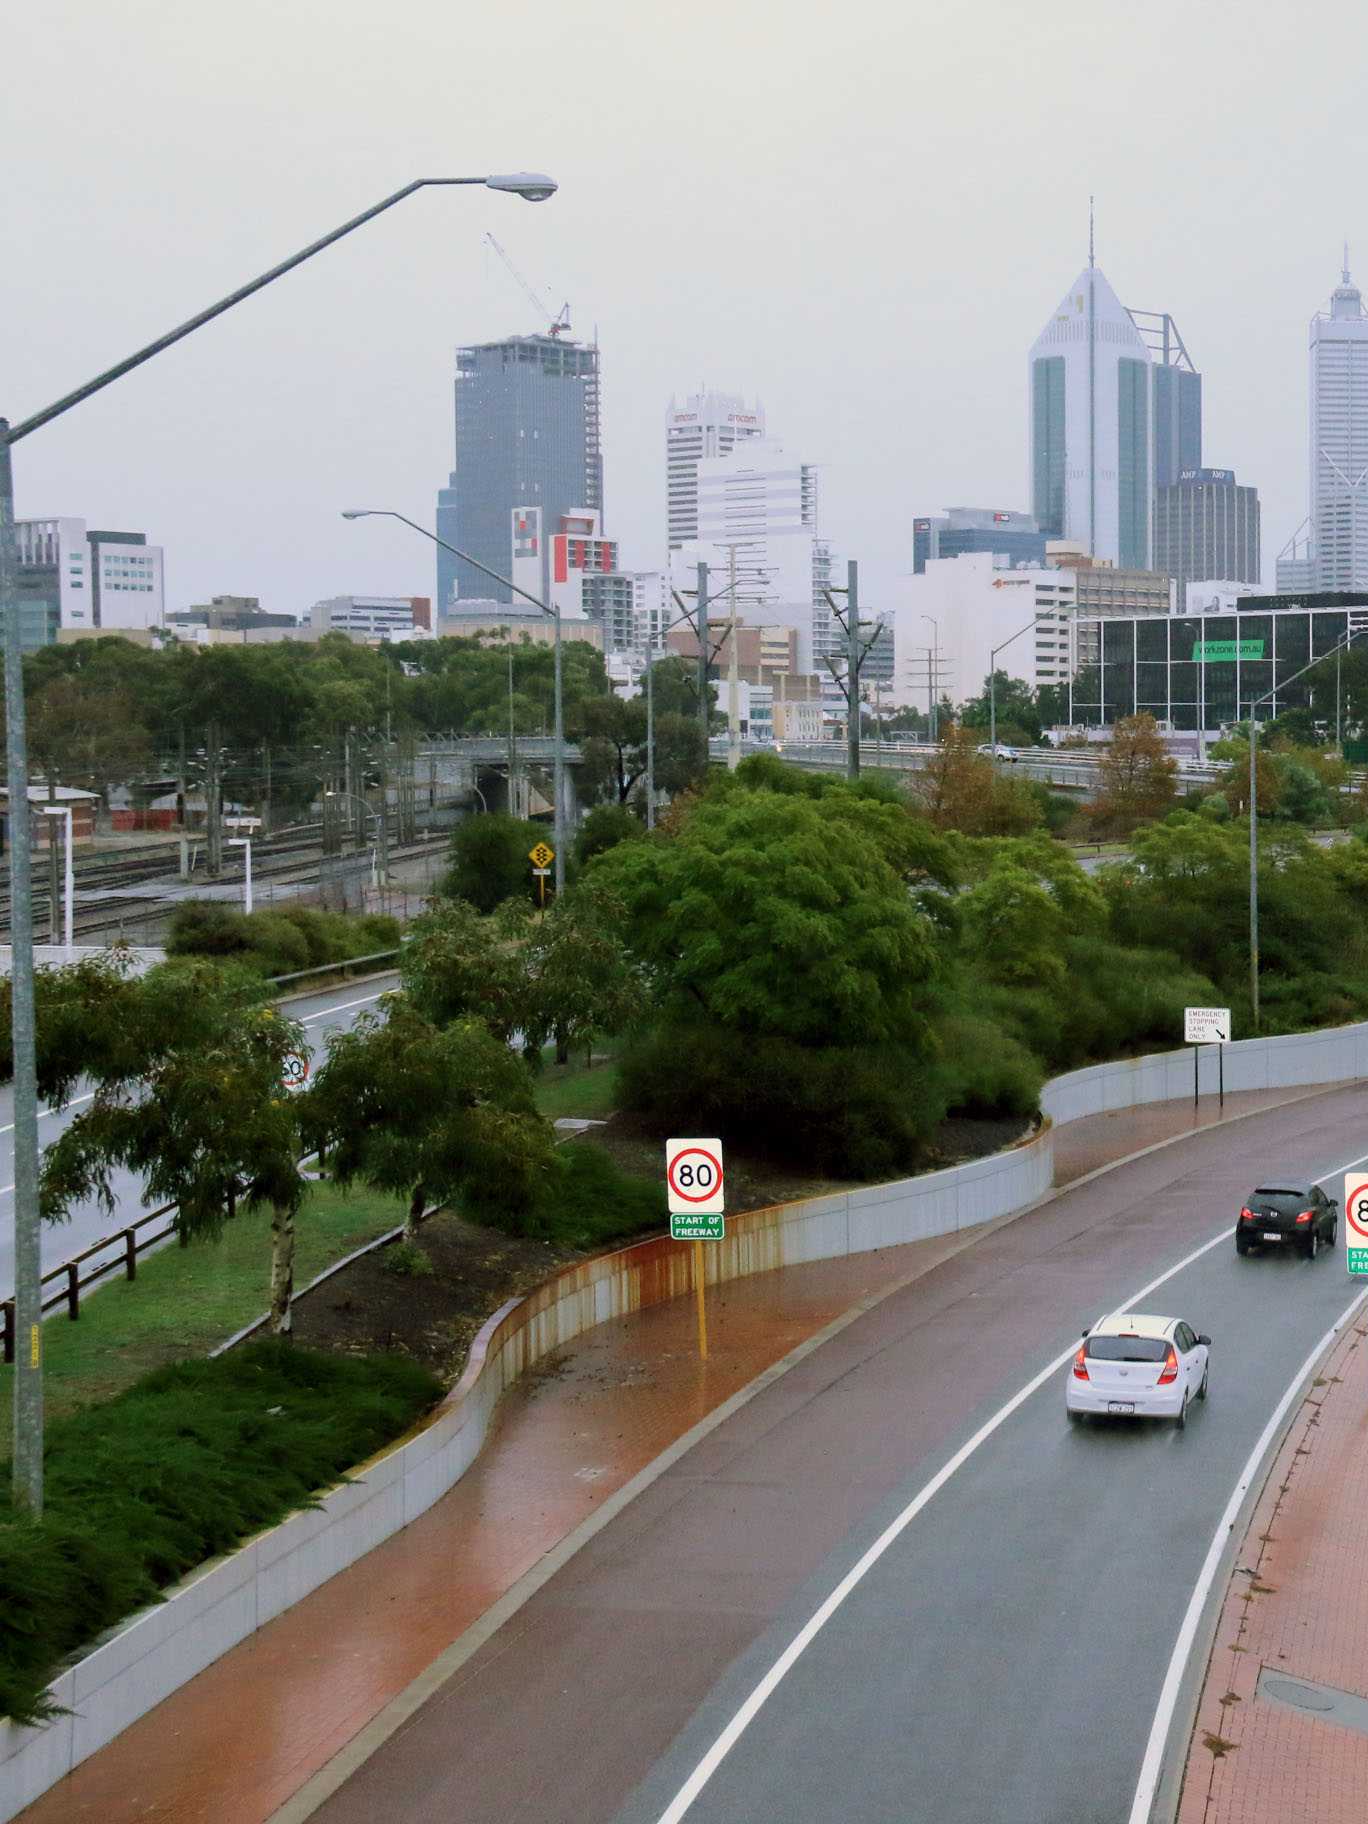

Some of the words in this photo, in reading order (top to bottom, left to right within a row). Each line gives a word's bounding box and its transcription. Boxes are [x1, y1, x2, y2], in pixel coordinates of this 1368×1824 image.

[1188, 1010, 1227, 1019] EMERGENCY
[1188, 1033, 1206, 1041] ONLY
[679, 1164, 712, 1187] 80
[674, 1216, 705, 1225] START
[708, 1216, 720, 1225] OF
[675, 1228, 720, 1236] FREEWAY
